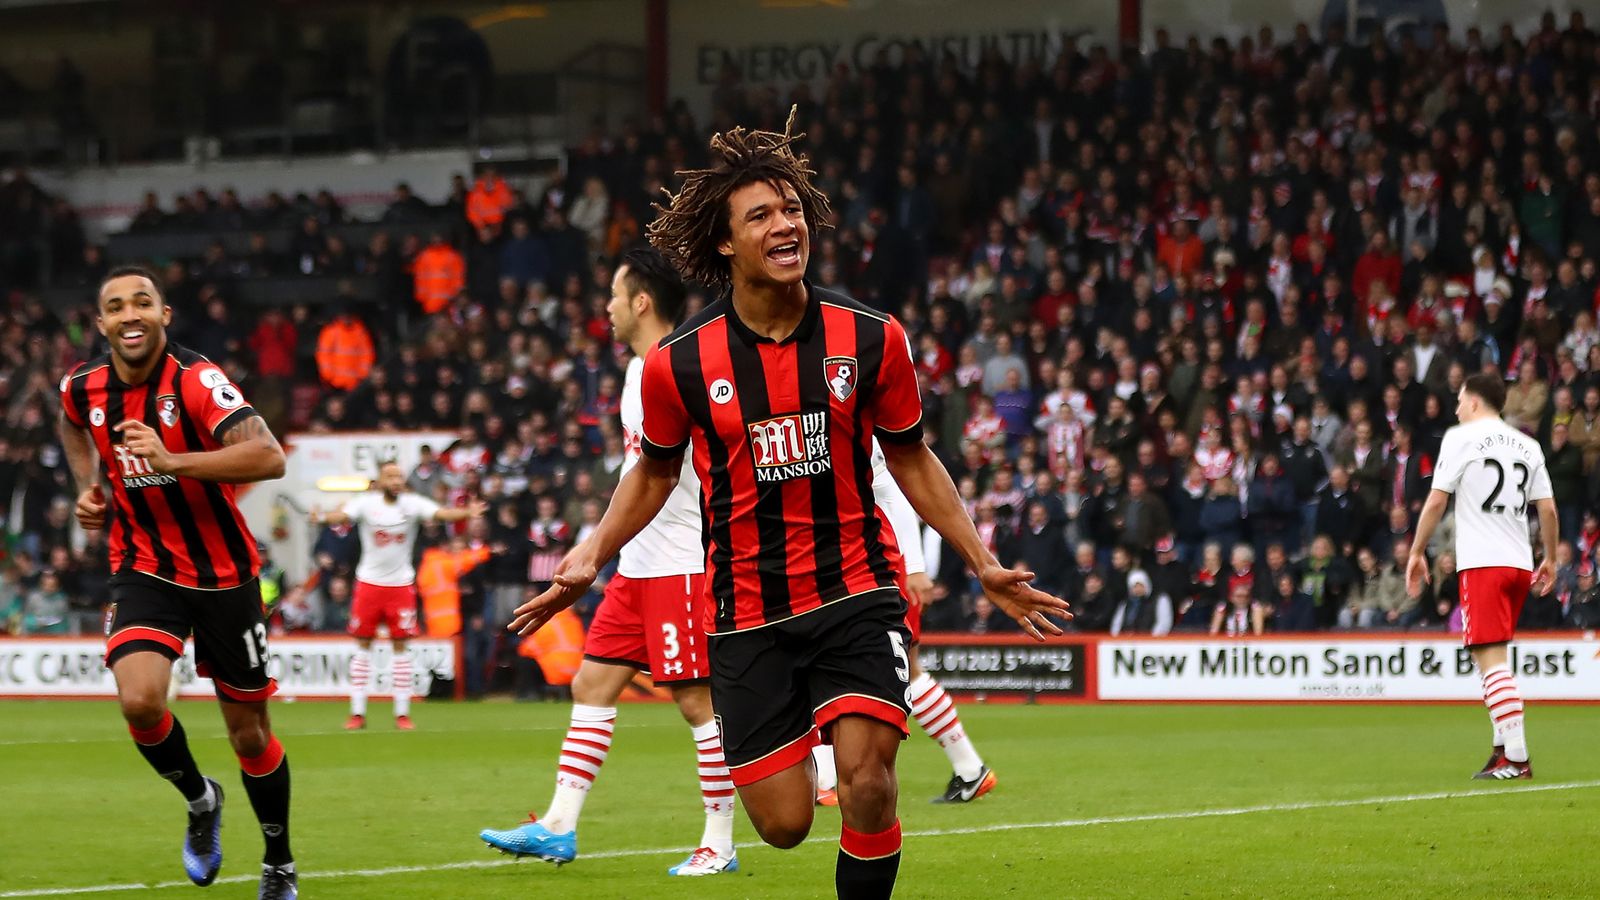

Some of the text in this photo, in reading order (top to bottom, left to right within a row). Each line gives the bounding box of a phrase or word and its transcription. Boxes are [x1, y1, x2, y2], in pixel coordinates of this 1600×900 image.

[697, 44, 839, 84] ENERGY
[715, 385, 729, 398] JD
[123, 474, 178, 489] MANSION
[757, 456, 831, 482] MANSION
[1481, 458, 1529, 516] 23
[242, 622, 269, 668] 13
[661, 623, 681, 659] 3
[886, 630, 910, 682] 5
[1112, 646, 1576, 676] New Milton Sand & Blast
